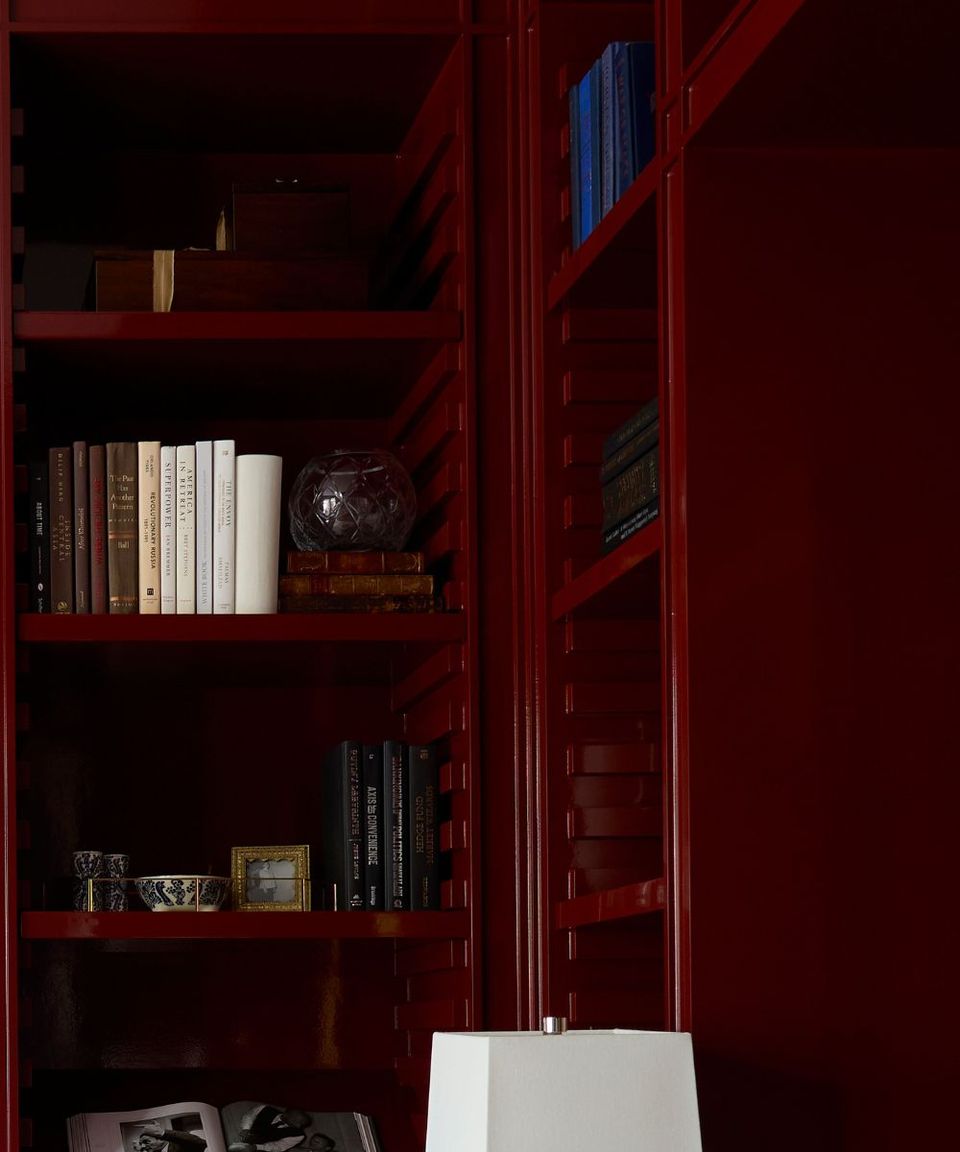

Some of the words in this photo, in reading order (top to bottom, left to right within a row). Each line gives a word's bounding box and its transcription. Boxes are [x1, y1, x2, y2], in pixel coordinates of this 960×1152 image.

[179, 461, 186, 474] IN
[164, 462, 172, 529] SUPERPOWER
[367, 786, 377, 804] AXIS
[367, 815, 377, 866] CONVENIENCE
[392, 825, 403, 862] POLITICS
